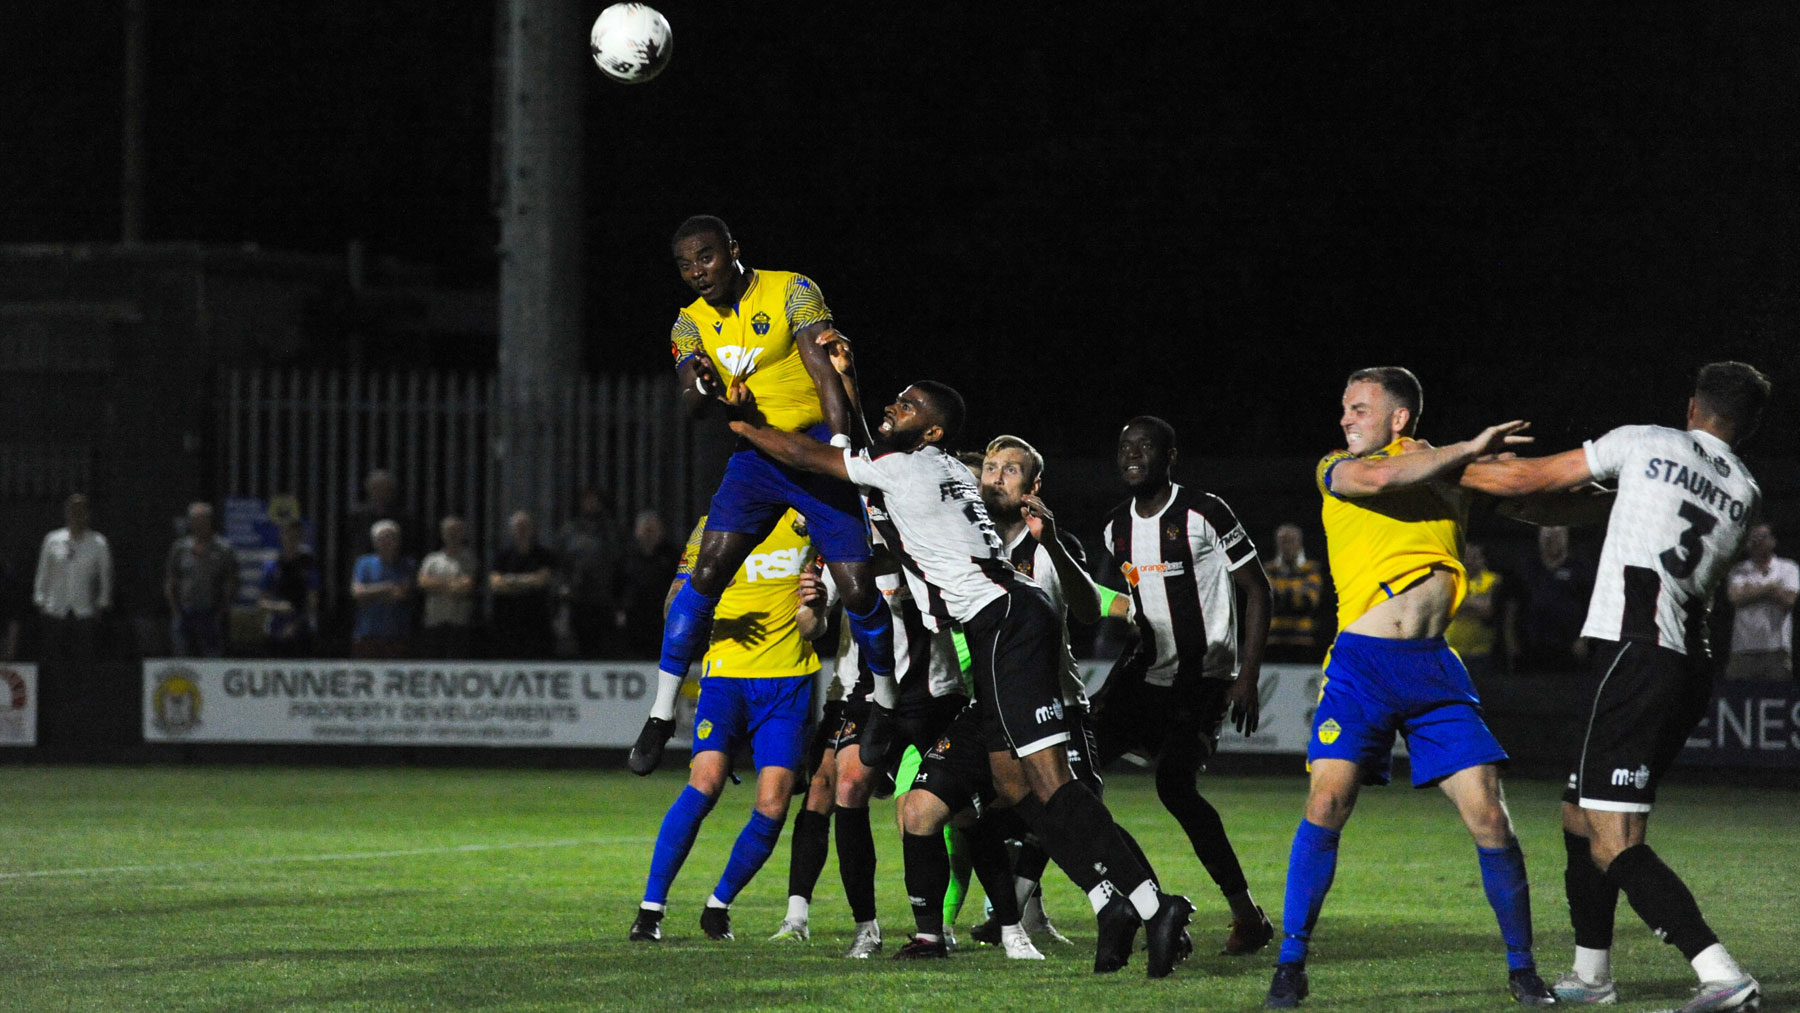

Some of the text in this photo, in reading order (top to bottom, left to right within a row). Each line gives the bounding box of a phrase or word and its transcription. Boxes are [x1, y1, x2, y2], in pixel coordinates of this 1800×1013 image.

[1645, 457, 1749, 522] STAUNTO
[1658, 499, 1719, 579] 3
[222, 668, 647, 701] GUNNER RENOVATE LTD
